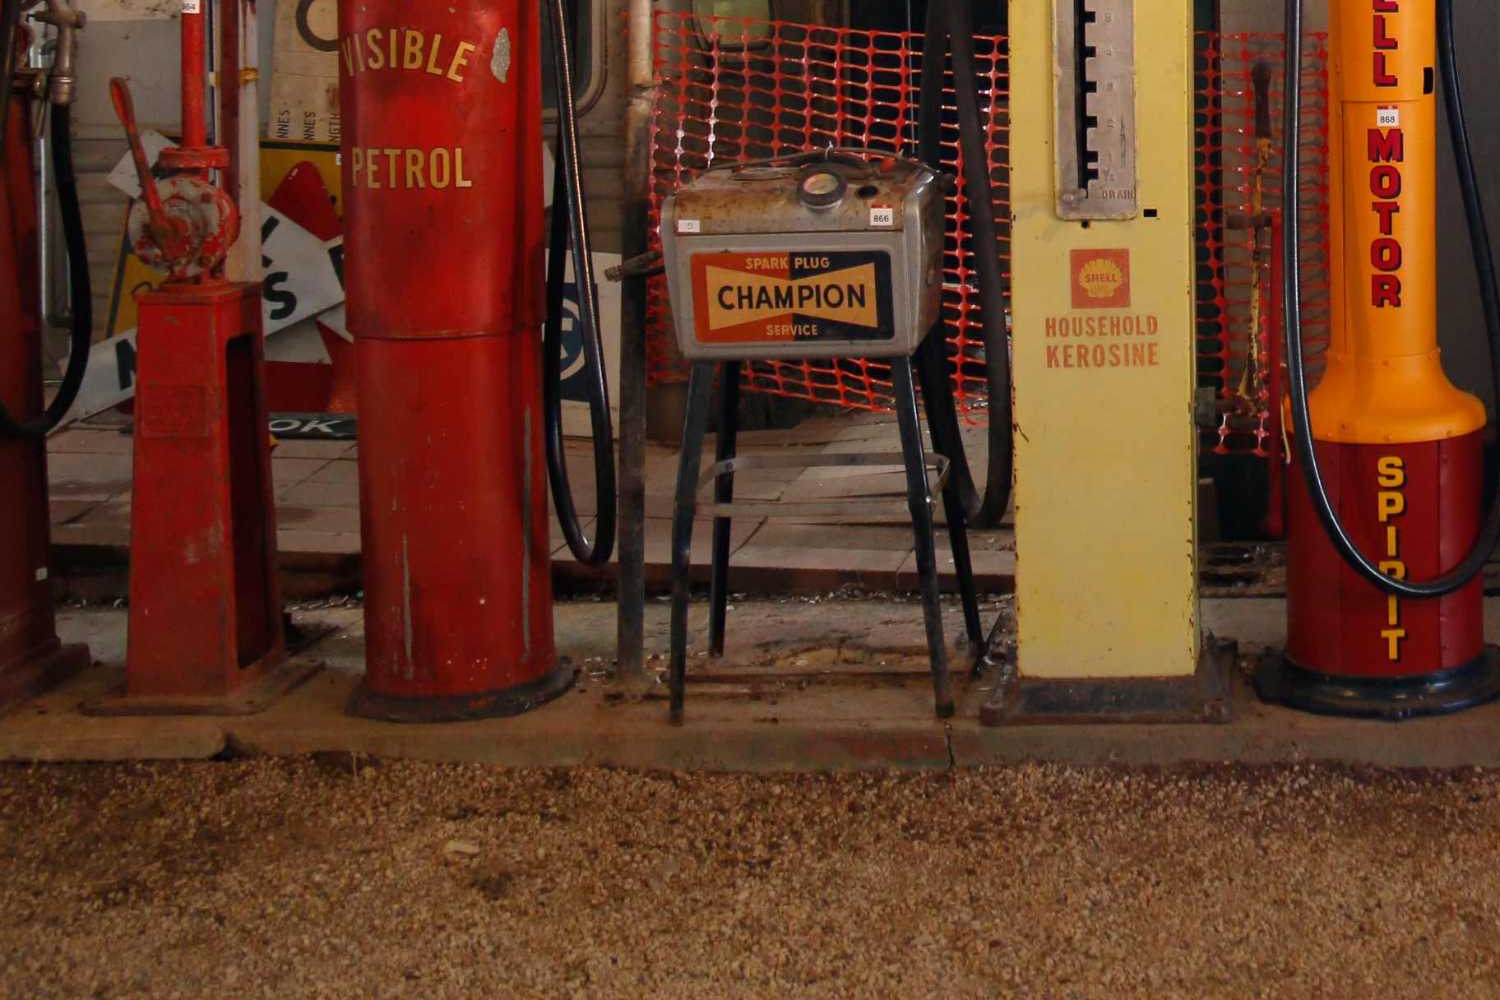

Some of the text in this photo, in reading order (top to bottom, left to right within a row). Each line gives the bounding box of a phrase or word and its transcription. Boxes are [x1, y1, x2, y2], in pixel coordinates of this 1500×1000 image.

[342, 27, 477, 83] VISIBLE
[352, 147, 472, 189] PETROL
[873, 214, 890, 223] 866
[1367, 128, 1404, 308] MOTOR
[745, 257, 831, 270] SPARK PLUG
[1086, 273, 1117, 283] SHELL
[717, 284, 866, 310] CHAMPION
[766, 324, 818, 337] SERVICE
[1045, 315, 1158, 337] HOUSEHOLD
[1046, 342, 1159, 368] KEROSINE
[1377, 456, 1406, 661] SPIRIT
